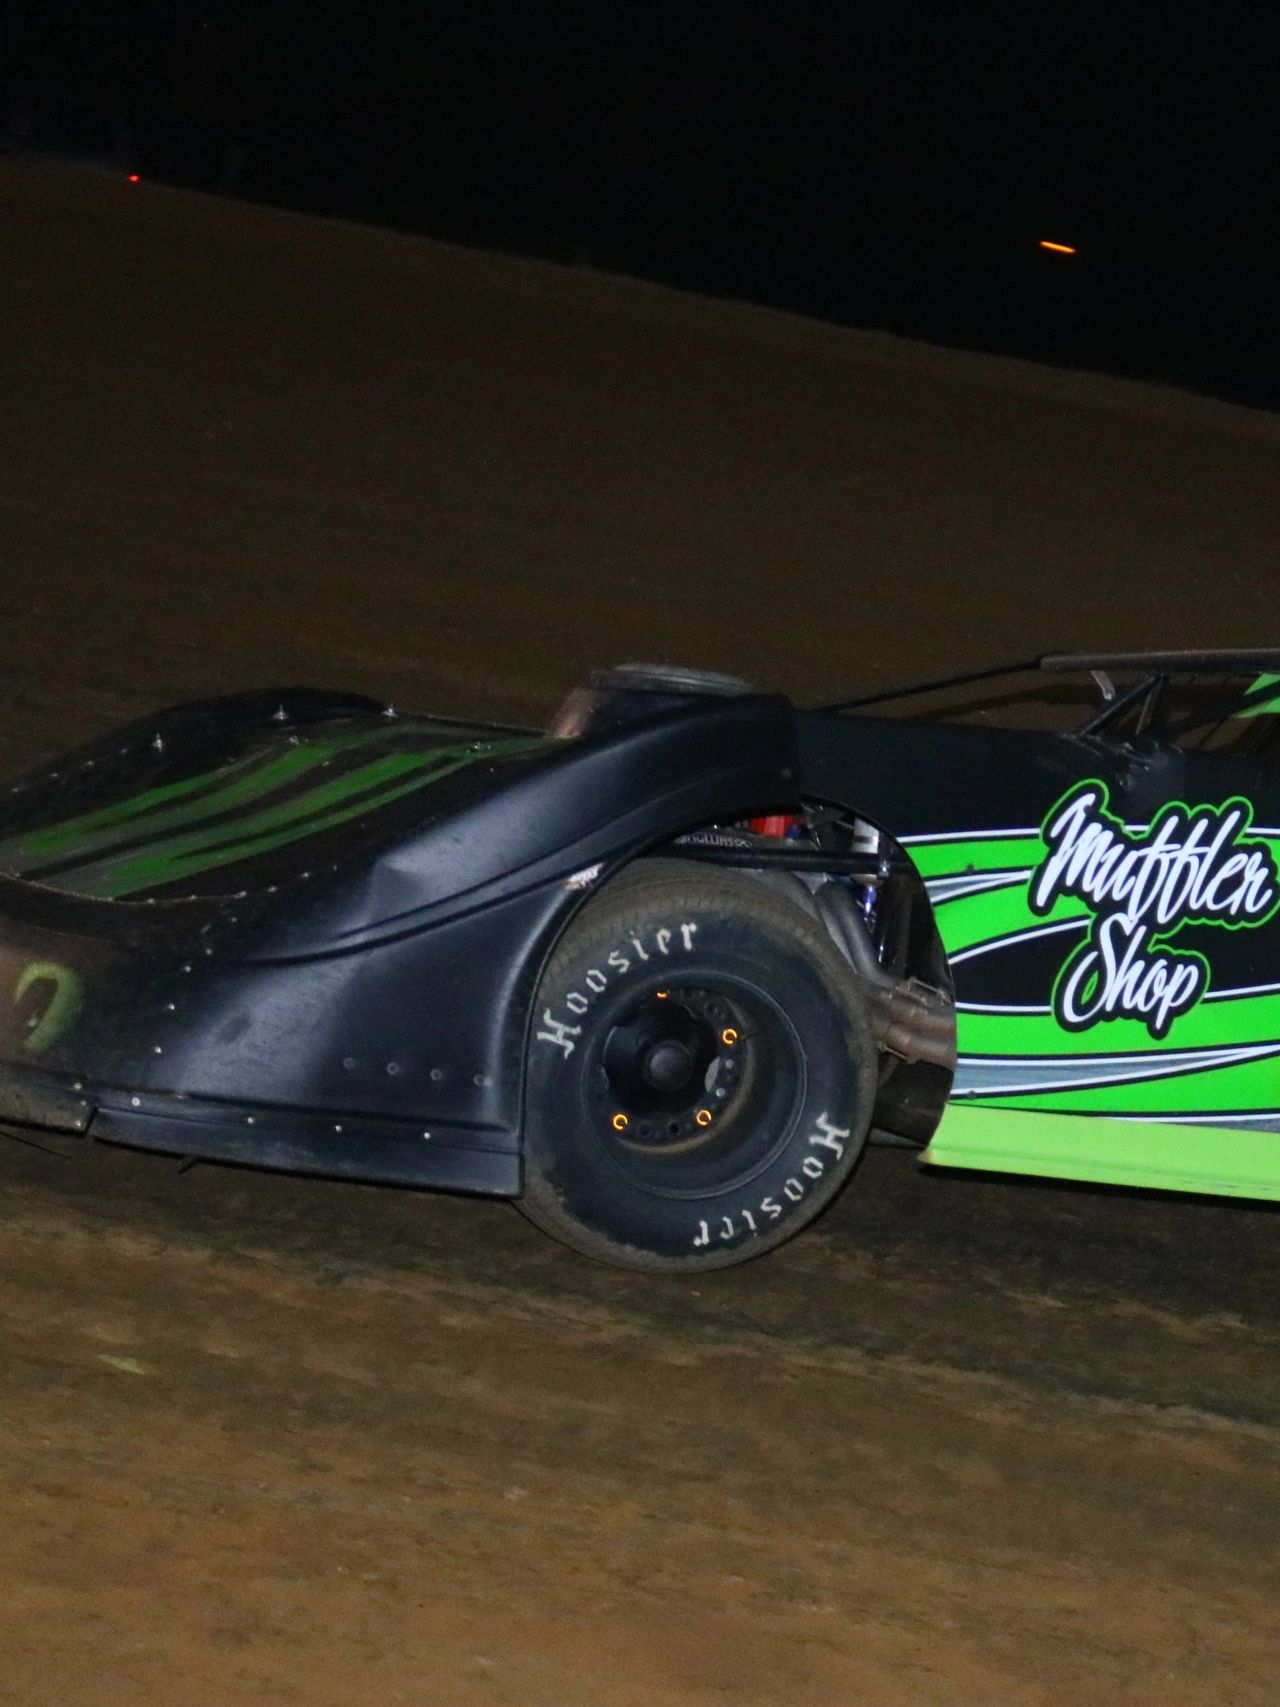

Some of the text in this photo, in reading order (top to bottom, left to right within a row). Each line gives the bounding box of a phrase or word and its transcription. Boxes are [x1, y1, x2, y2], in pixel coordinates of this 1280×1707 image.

[1035, 790, 1279, 930] Muffler
[536, 921, 699, 1059] Hoosier
[1060, 912, 1200, 1032] Shop
[692, 1112, 851, 1247] Hoosier
